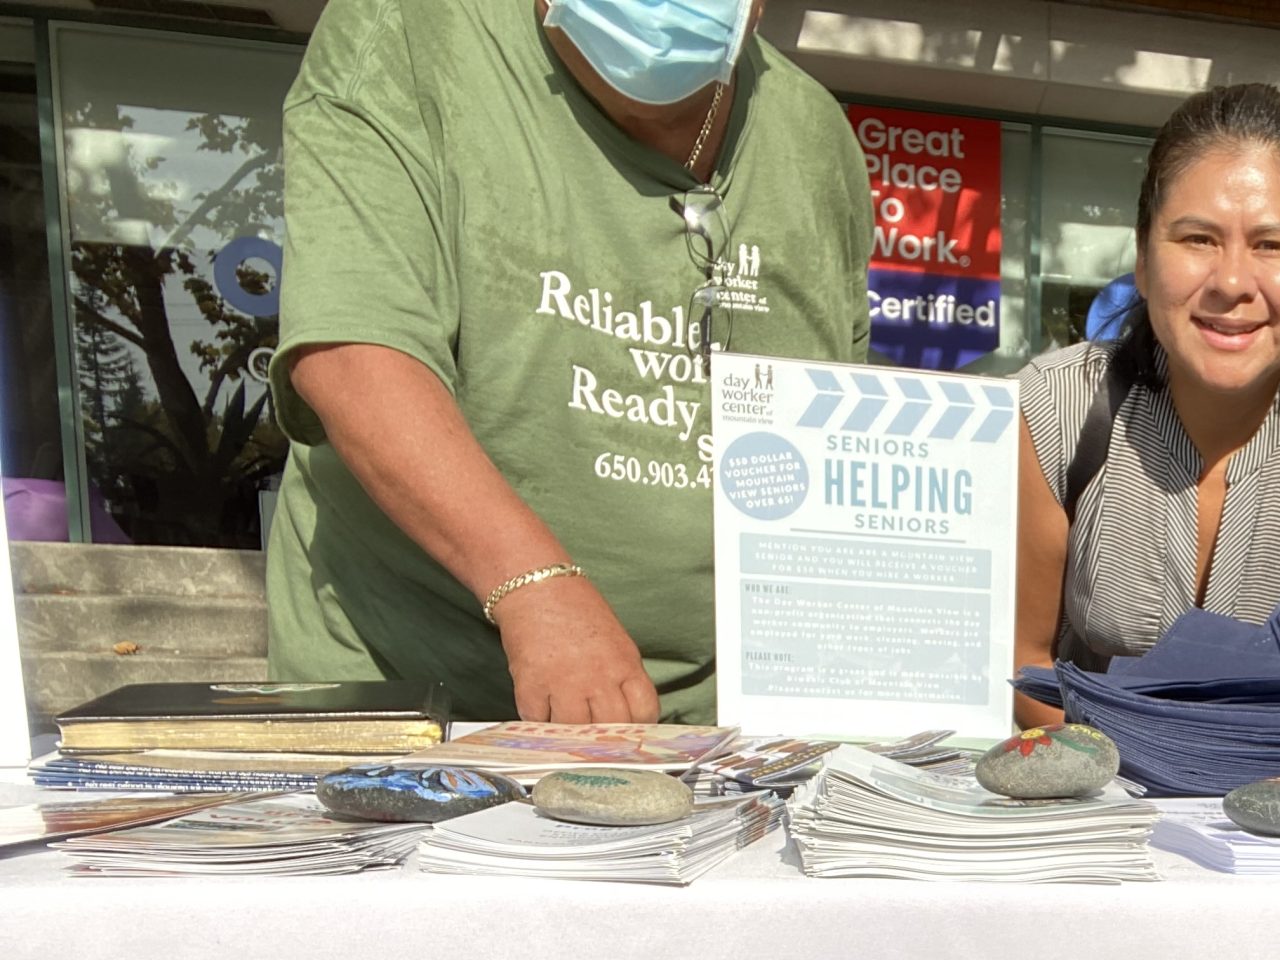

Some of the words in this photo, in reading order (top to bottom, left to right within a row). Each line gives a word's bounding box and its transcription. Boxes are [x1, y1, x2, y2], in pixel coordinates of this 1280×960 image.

[858, 118, 964, 158] Great
[866, 154, 961, 192] Place
[536, 271, 702, 351] Reliable
[866, 291, 996, 327] Certified
[723, 373, 750, 391] day
[568, 364, 700, 441] Ready
[722, 388, 773, 404] worker
[721, 402, 767, 416] center
[722, 415, 757, 424] mountain
[826, 434, 930, 459] SENIORS
[750, 451, 793, 465] DOLLAR
[724, 463, 776, 479] VOUCHER
[779, 462, 801, 472] FOR
[735, 473, 795, 488] MOUNTAIN
[823, 458, 973, 516] HELPING
[729, 487, 757, 500] VIEW
[760, 482, 806, 496] SENIORS
[746, 496, 775, 508] OVER
[853, 513, 950, 535] SENIORS
[745, 583, 761, 593] WHO
[763, 585, 774, 594] WE
[745, 651, 772, 662] PLEASE
